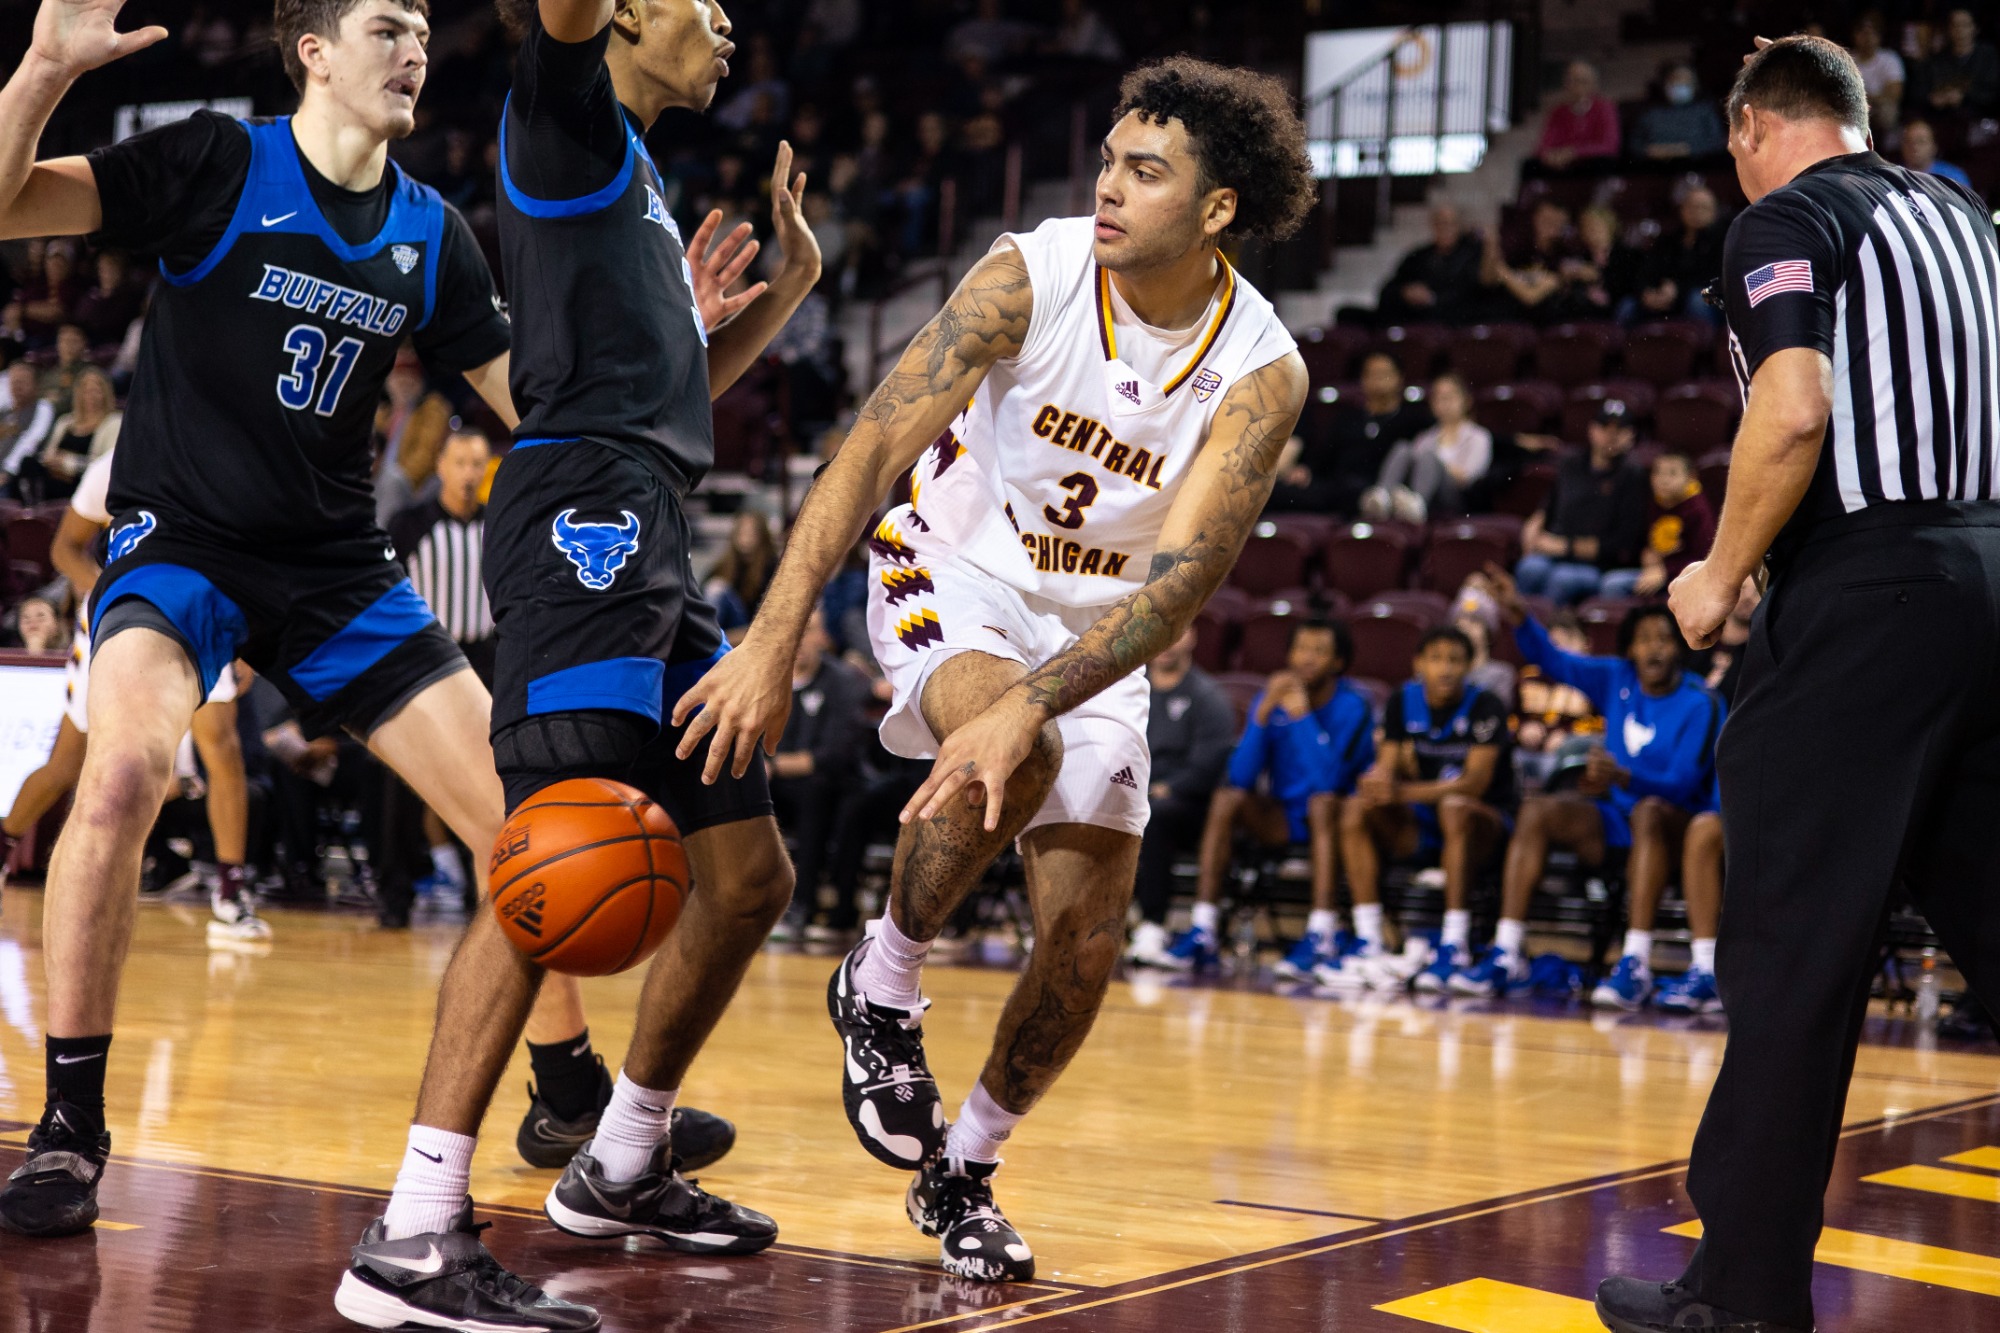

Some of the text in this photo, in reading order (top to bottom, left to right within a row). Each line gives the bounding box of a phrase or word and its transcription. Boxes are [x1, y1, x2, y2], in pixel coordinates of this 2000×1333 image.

[249, 263, 407, 337] BUFFALO
[277, 324, 365, 417] 31
[1114, 383, 1142, 405] adidas
[1031, 403, 1167, 491] CENTRAL
[1043, 470, 1099, 530] 3
